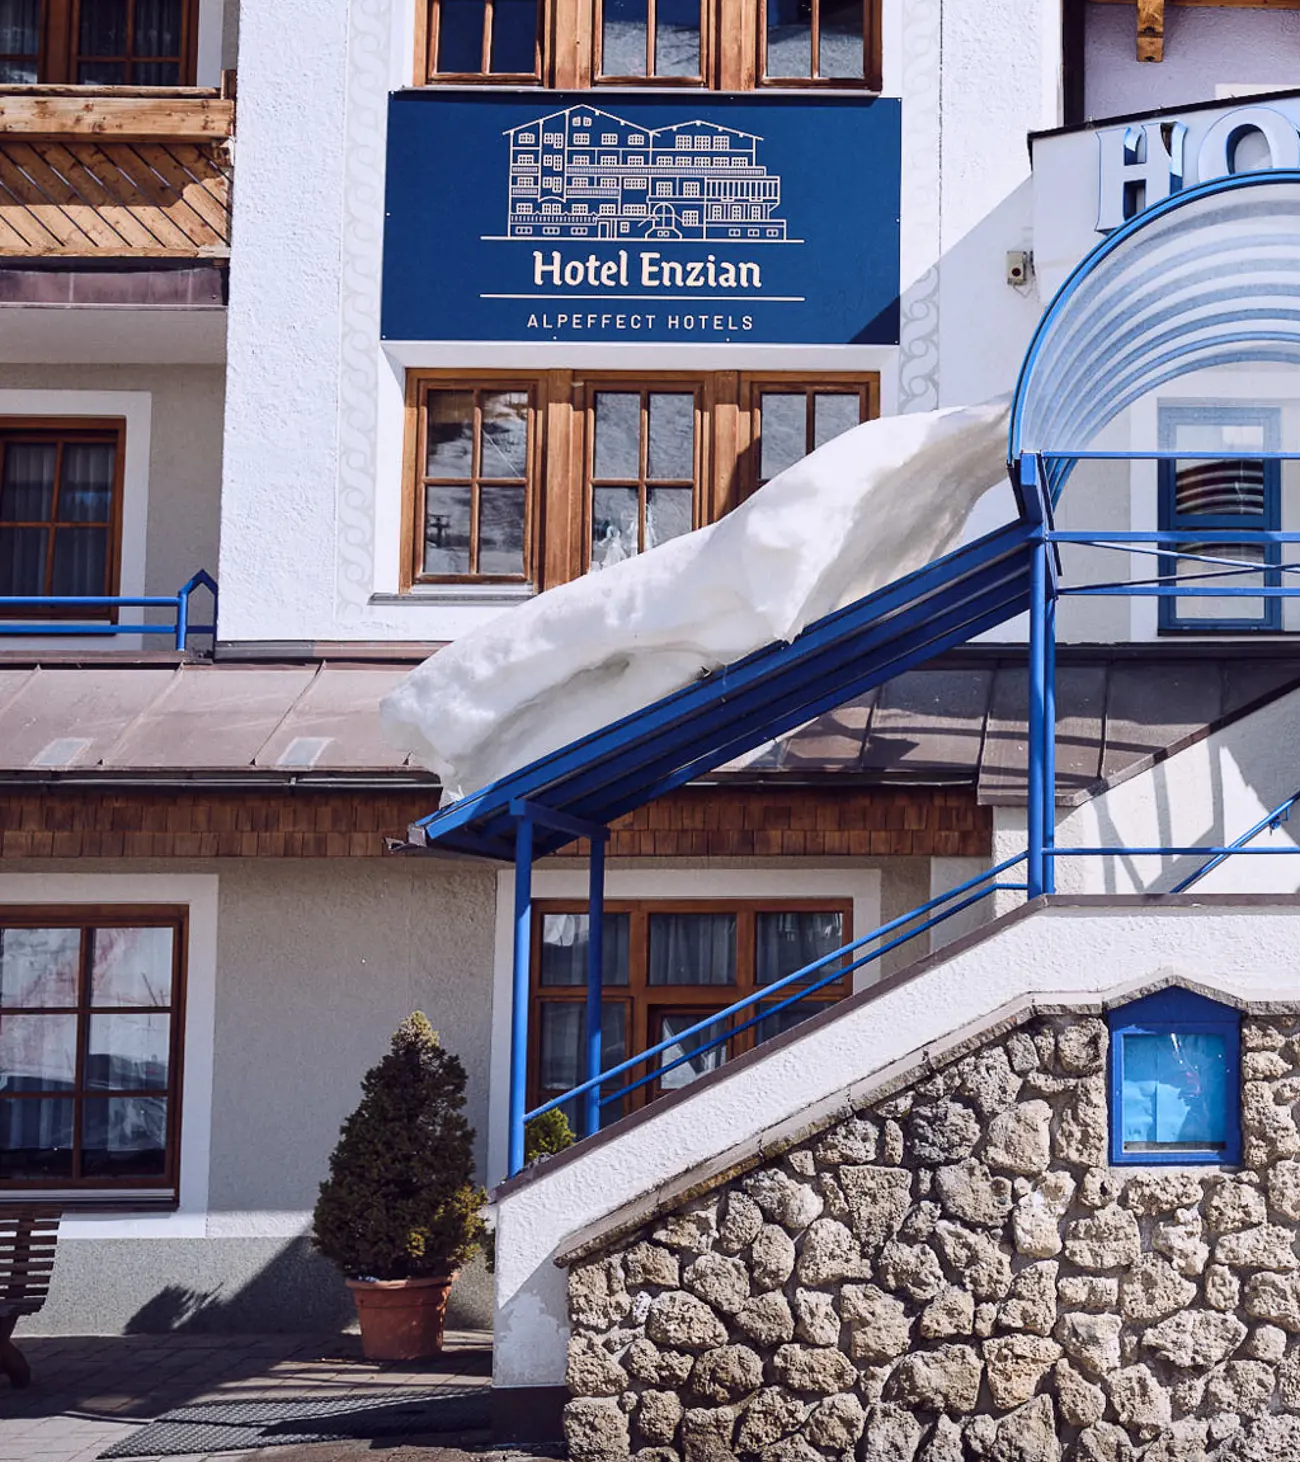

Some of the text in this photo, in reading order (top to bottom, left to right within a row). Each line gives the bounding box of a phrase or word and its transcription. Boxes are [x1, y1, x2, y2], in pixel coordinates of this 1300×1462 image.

[532, 249, 762, 288] Hotel Enzian
[527, 314, 753, 331] ALPEFFECT HOTELS
